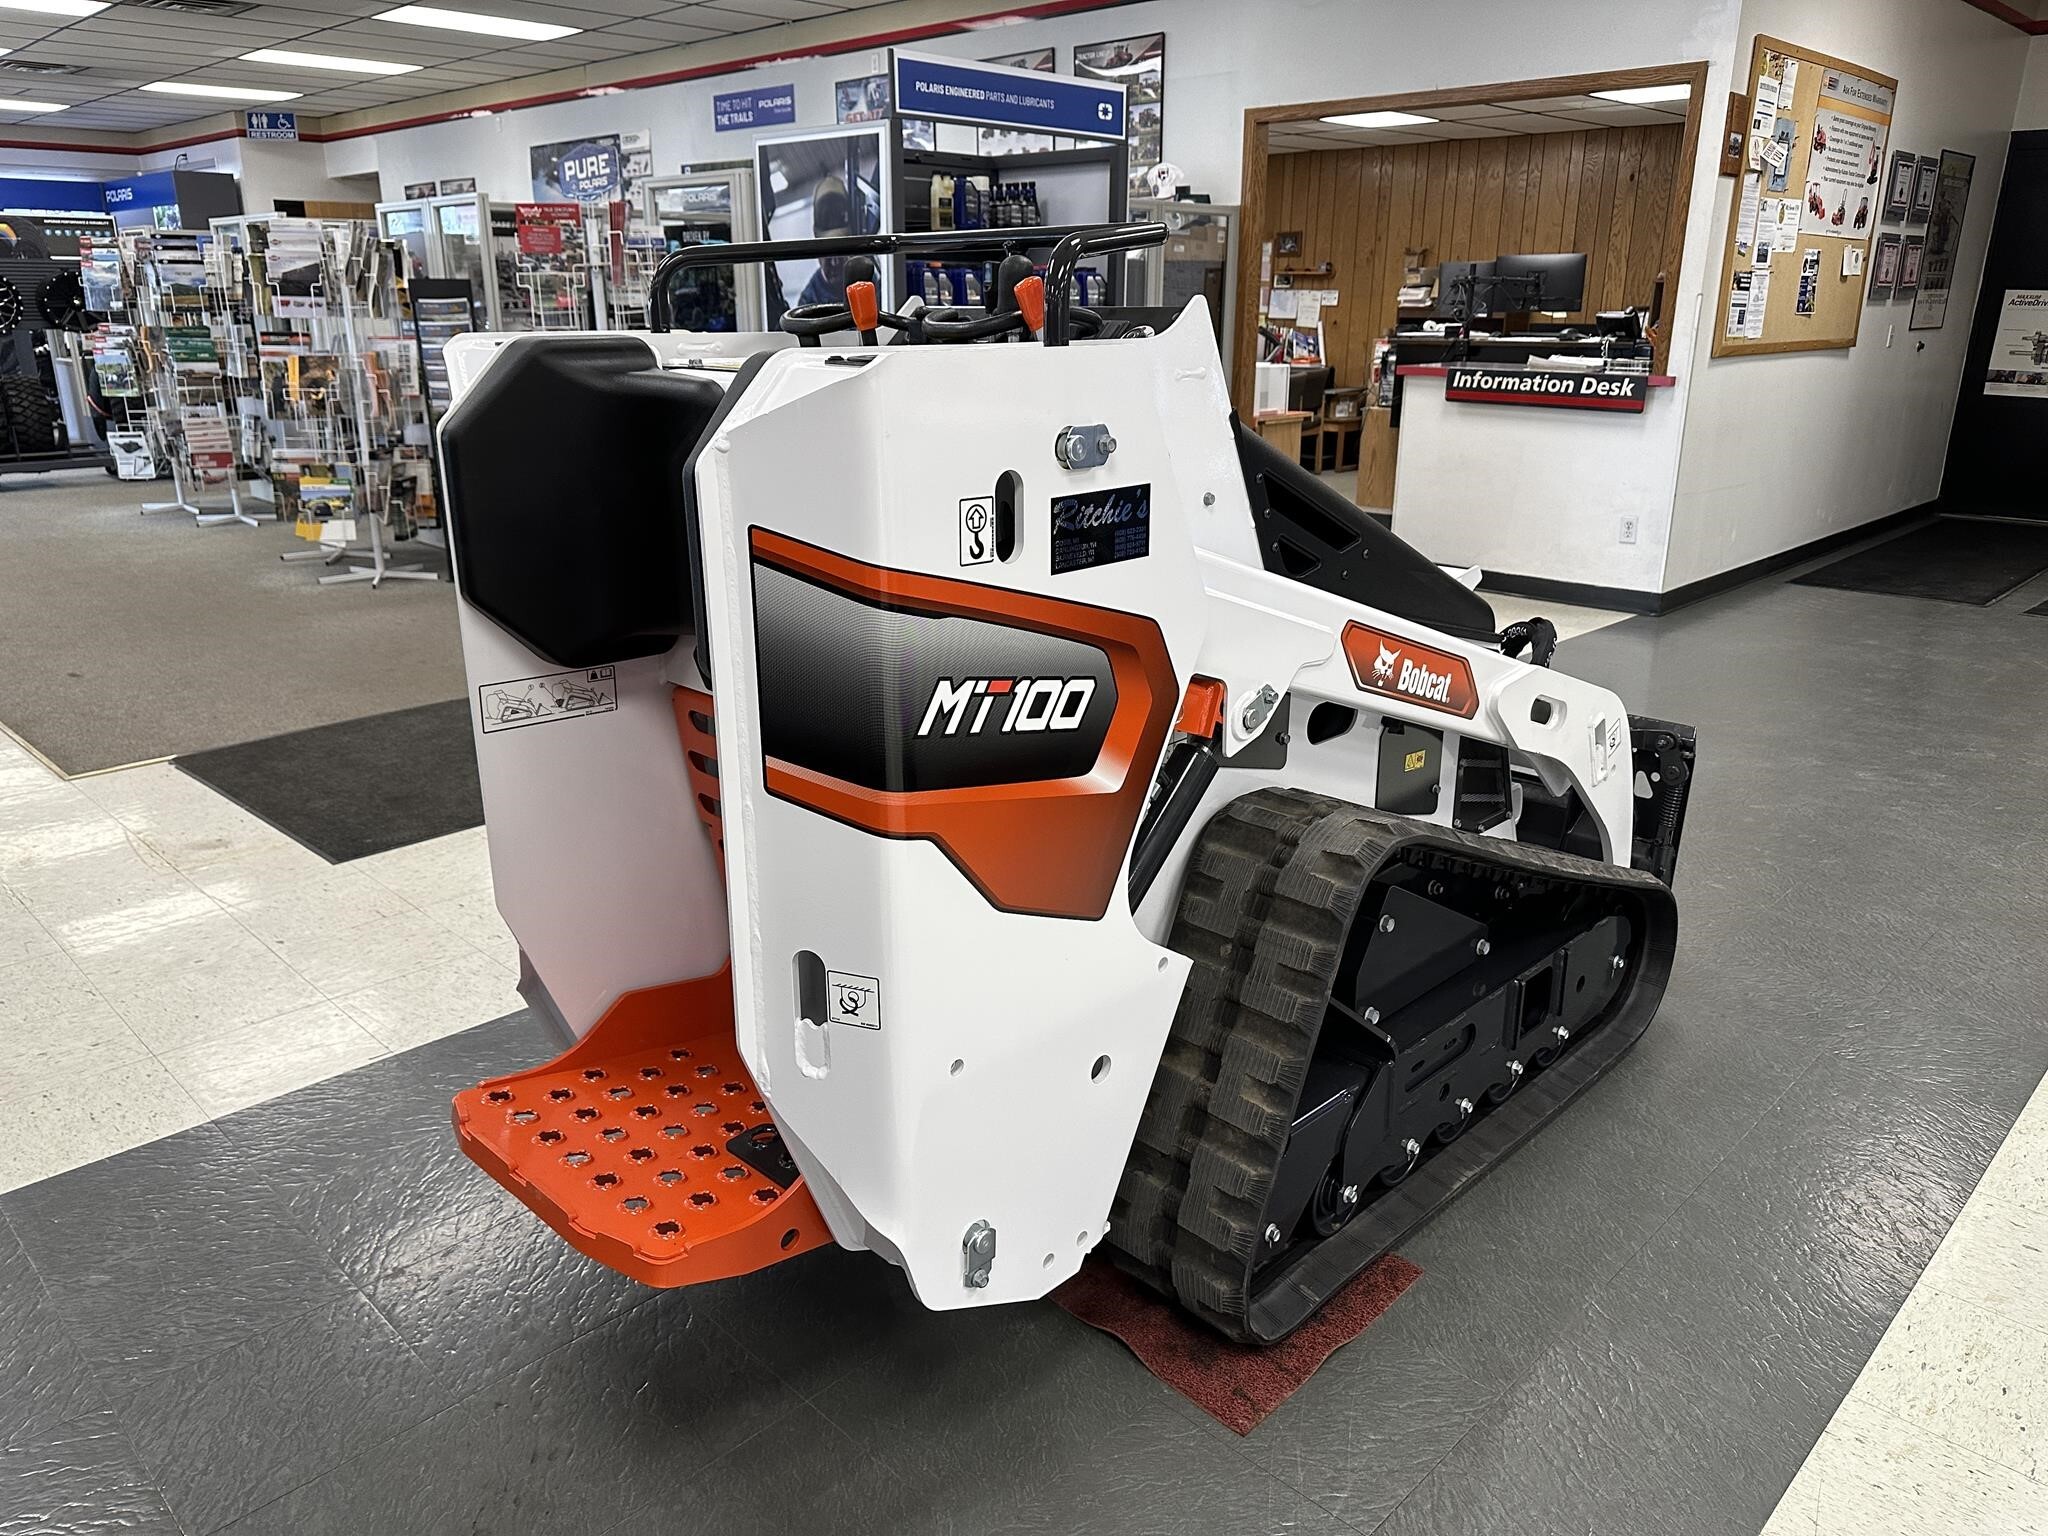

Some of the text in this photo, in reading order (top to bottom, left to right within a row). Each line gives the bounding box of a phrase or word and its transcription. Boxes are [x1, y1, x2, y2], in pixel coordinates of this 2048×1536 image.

[758, 96, 791, 108] POLARIS
[915, 81, 1055, 110] POLARIS ENGINEERED PARTS AND LUBRICANTS
[716, 99, 731, 112] TIME
[717, 111, 754, 125] THE TRAILS
[250, 131, 295, 139] RESTROOM
[564, 153, 611, 181] PURE
[579, 176, 608, 190] POLARIS
[105, 187, 133, 203] POLARIS
[1452, 371, 1635, 397] Information Desk
[1053, 488, 1148, 535] Ritchie's
[915, 678, 1097, 737] MT100
